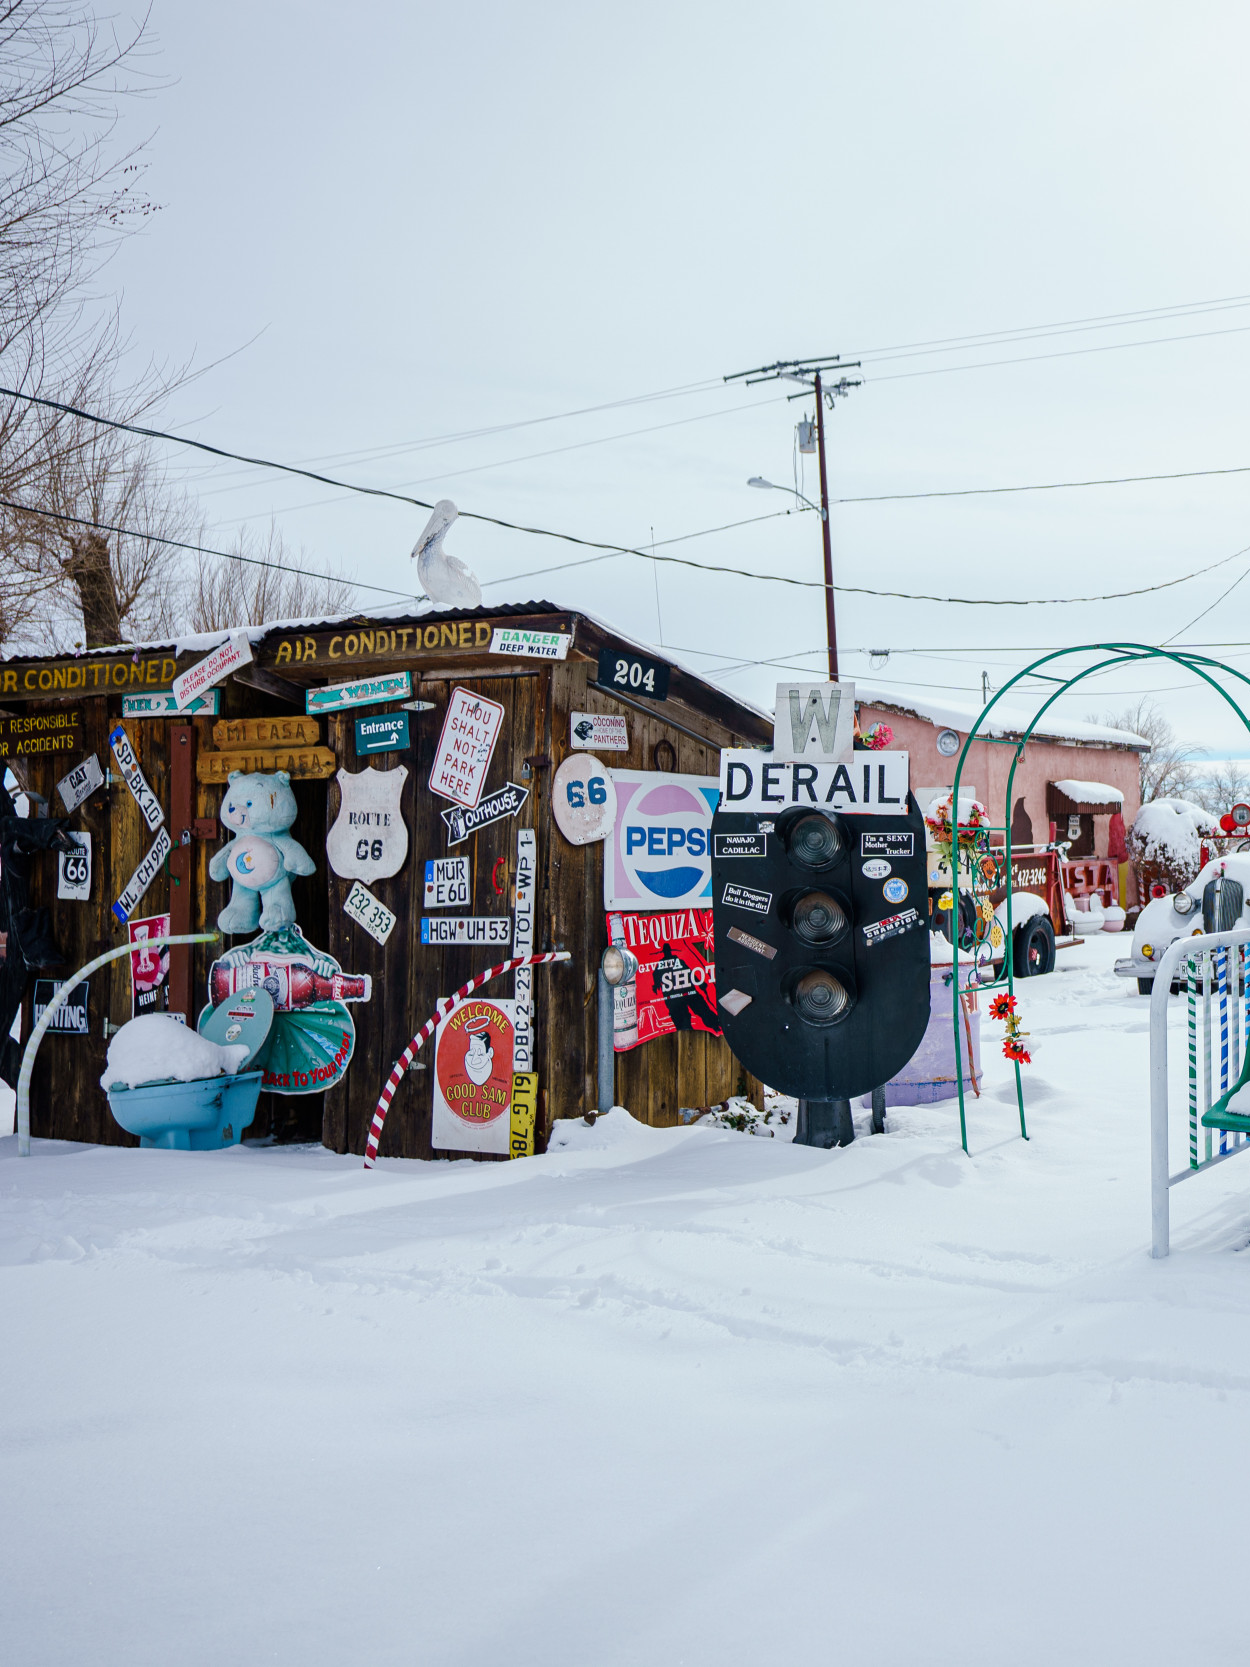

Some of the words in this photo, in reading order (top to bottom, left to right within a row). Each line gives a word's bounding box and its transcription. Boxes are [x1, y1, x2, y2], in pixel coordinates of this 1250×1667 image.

[275, 636, 317, 665] AIR
[329, 621, 492, 659] CONDITIONED
[501, 630, 560, 645] DANGER
[499, 643, 524, 653] DEEP
[527, 645, 557, 656] WATER
[0, 670, 18, 692] R
[24, 658, 177, 690] CONDITIONED
[179, 676, 206, 700] DISTURB
[207, 650, 240, 679] OCCUPANT
[182, 665, 206, 686] PLEASE
[208, 657, 218, 668] DO
[219, 645, 233, 659] NOT
[613, 659, 655, 692] 204
[345, 677, 404, 698] WOMEN
[127, 698, 152, 711] MEN
[459, 700, 492, 725] THOU
[10, 712, 79, 733] RESPONSIBLE
[226, 725, 247, 741] MI
[256, 723, 307, 742] CASA
[360, 719, 404, 735] Entrance
[450, 717, 490, 744] SHALT
[592, 717, 625, 728] COCONINO
[788, 689, 842, 753] W
[16, 735, 74, 754] ACCIDENTS
[453, 737, 477, 759] NOT
[593, 734, 627, 745] PANTHERS
[69, 766, 88, 789] CAT
[116, 743, 132, 765] SP
[129, 773, 149, 801] BK
[444, 753, 477, 779] PARK
[439, 771, 472, 797] HERE
[726, 762, 901, 804] DERAIL
[348, 810, 392, 828] ROUTE
[465, 790, 519, 827] OUTHOUSE
[67, 847, 85, 856] OUTE
[626, 826, 712, 856] PEPSI
[726, 836, 755, 844] NAVAJO
[67, 858, 87, 880] 66
[119, 891, 138, 912] WL
[728, 887, 741, 896] Bull
[742, 890, 768, 903] Doggers
[739, 897, 745, 905] in
[745, 899, 755, 908] the
[755, 901, 767, 911] dirt
[349, 888, 371, 916] 232
[369, 906, 391, 934] 353
[430, 921, 457, 941] HGW
[467, 921, 485, 940] UH
[489, 921, 508, 940] 53
[623, 909, 699, 949] TEQUIZA
[866, 913, 918, 939] CHAMPION
[737, 937, 765, 953] ASSISTANT
[741, 933, 766, 949] RESIDENT
[334, 975, 344, 1000] Bud
[661, 965, 716, 992] SHOT
[35, 1004, 86, 1029] HNTING
[450, 1003, 510, 1034] WELCOME
[261, 1068, 290, 1087] BACK
[292, 1071, 309, 1087] TO
[309, 1061, 337, 1084] YOUR
[335, 1031, 351, 1067] PAD!
[446, 1083, 477, 1101] GOOD
[481, 1085, 507, 1106] SAM
[461, 1101, 491, 1119] CLUB
